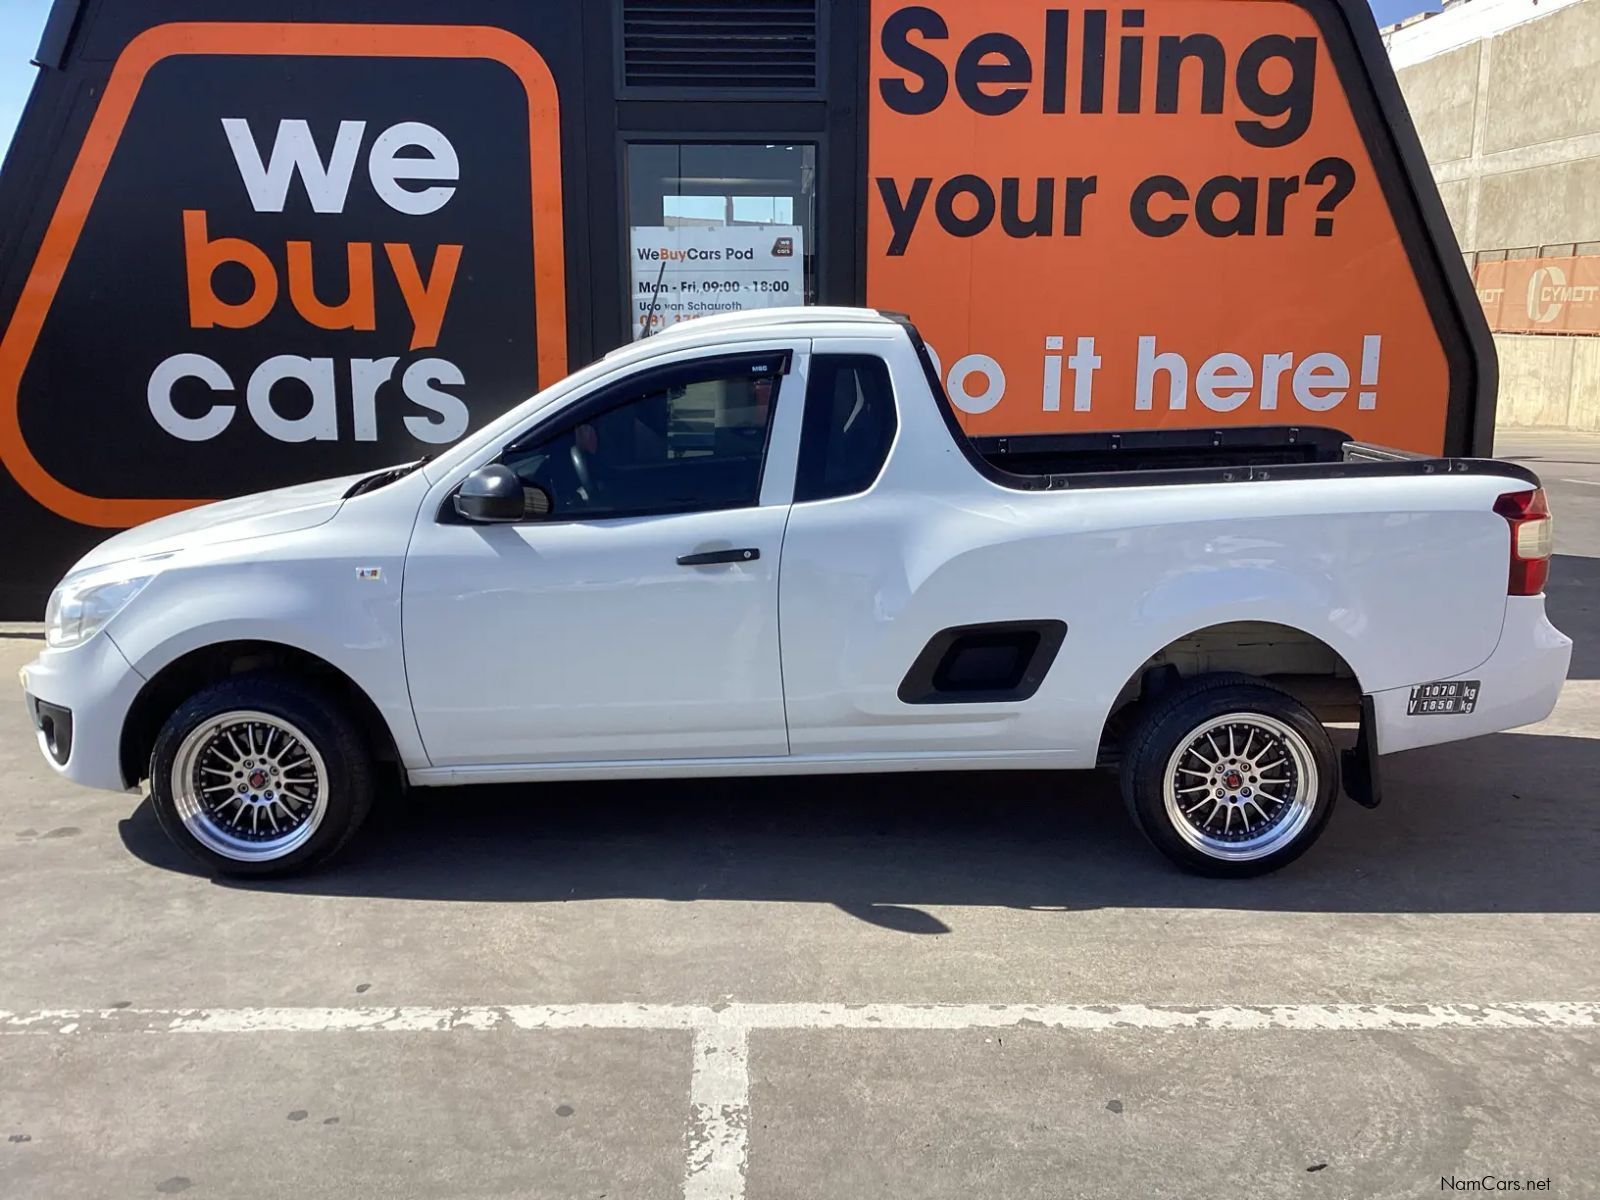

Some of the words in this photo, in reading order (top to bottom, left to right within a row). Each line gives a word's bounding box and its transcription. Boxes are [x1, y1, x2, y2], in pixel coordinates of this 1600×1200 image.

[878, 6, 1317, 148] Selling
[221, 118, 459, 215] we
[876, 174, 1097, 256] your
[1129, 157, 1356, 238] car?
[637, 248, 721, 263] WeBuyCars
[725, 248, 754, 260] Pod
[182, 210, 463, 351] buy
[680, 281, 699, 294] Fri,
[702, 281, 740, 293] 09:00
[753, 281, 789, 292] 18:00
[1541, 286, 1599, 302] CYMOT
[687, 301, 742, 311] Schauroth
[1042, 336, 1101, 412] it
[1134, 335, 1381, 412] here!
[147, 353, 469, 444] cars
[1409, 700, 1417, 713] V
[1422, 700, 1453, 711] 1850
[1460, 700, 1473, 713] kg
[1412, 686, 1420, 698] T
[1424, 686, 1456, 697] 1070
[1464, 686, 1476, 699] kg
